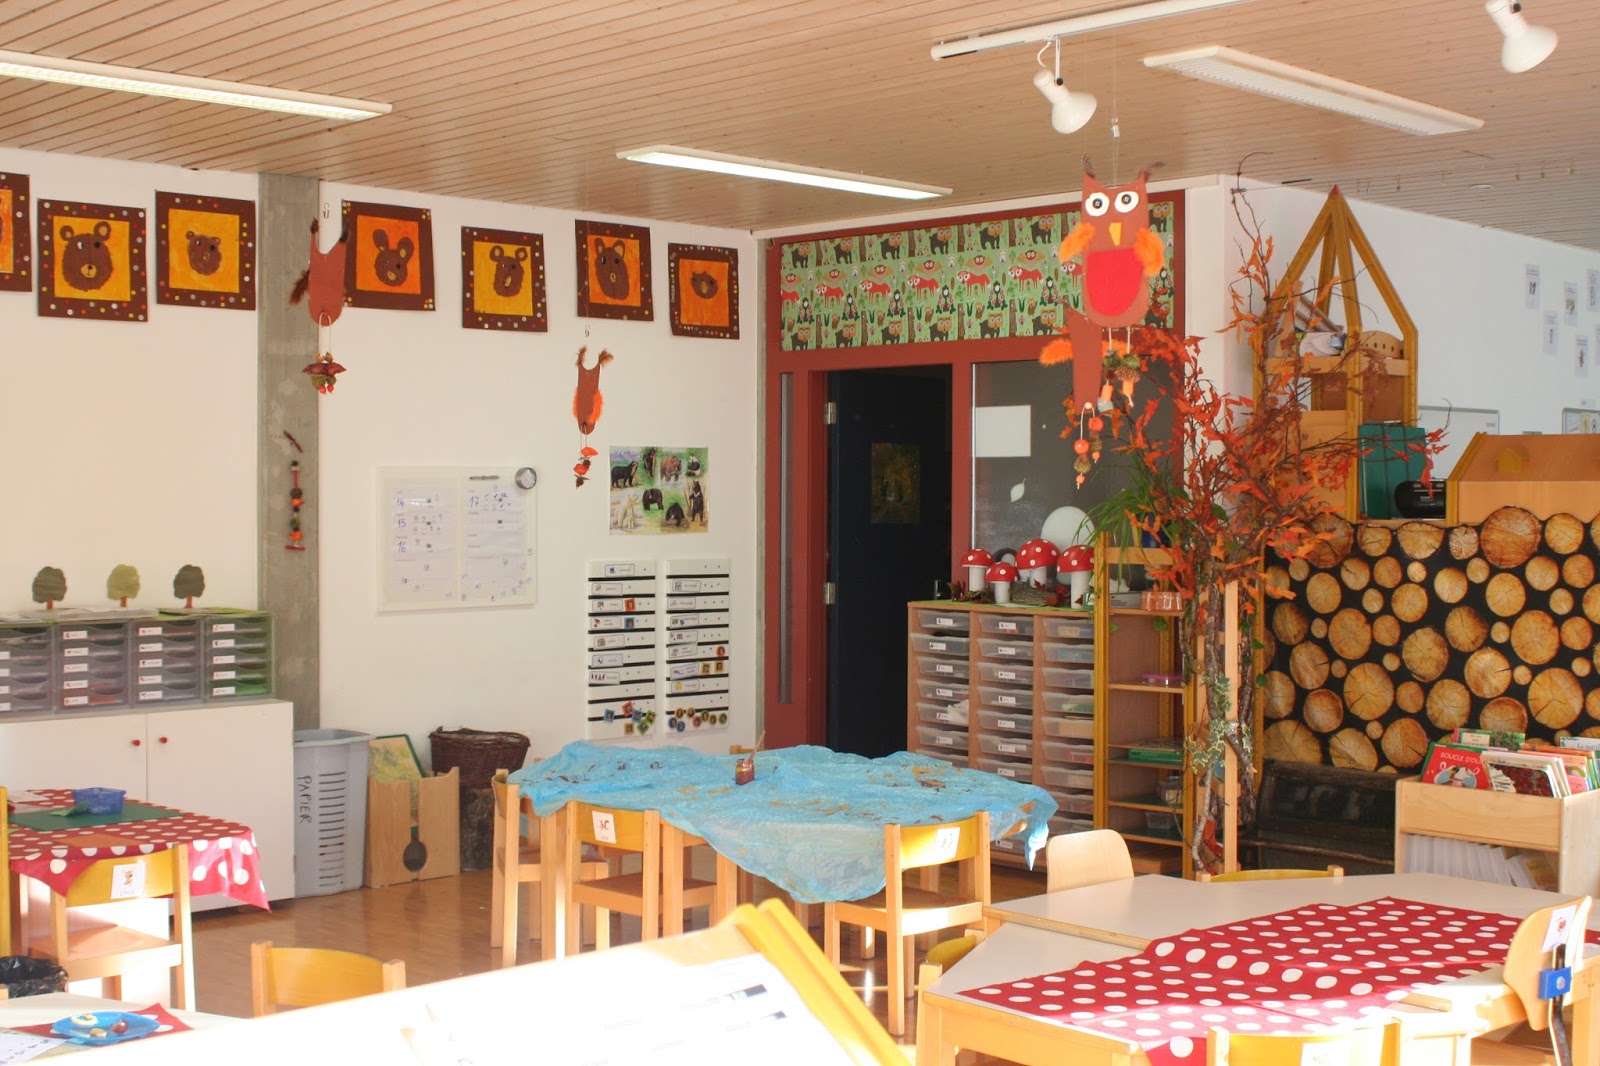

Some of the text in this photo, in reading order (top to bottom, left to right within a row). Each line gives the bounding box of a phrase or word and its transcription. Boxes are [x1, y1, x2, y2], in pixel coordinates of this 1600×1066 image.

[397, 518, 407, 528] 15
[1440, 752, 1464, 762] BOUCLE
[296, 775, 312, 823] PAPIER
